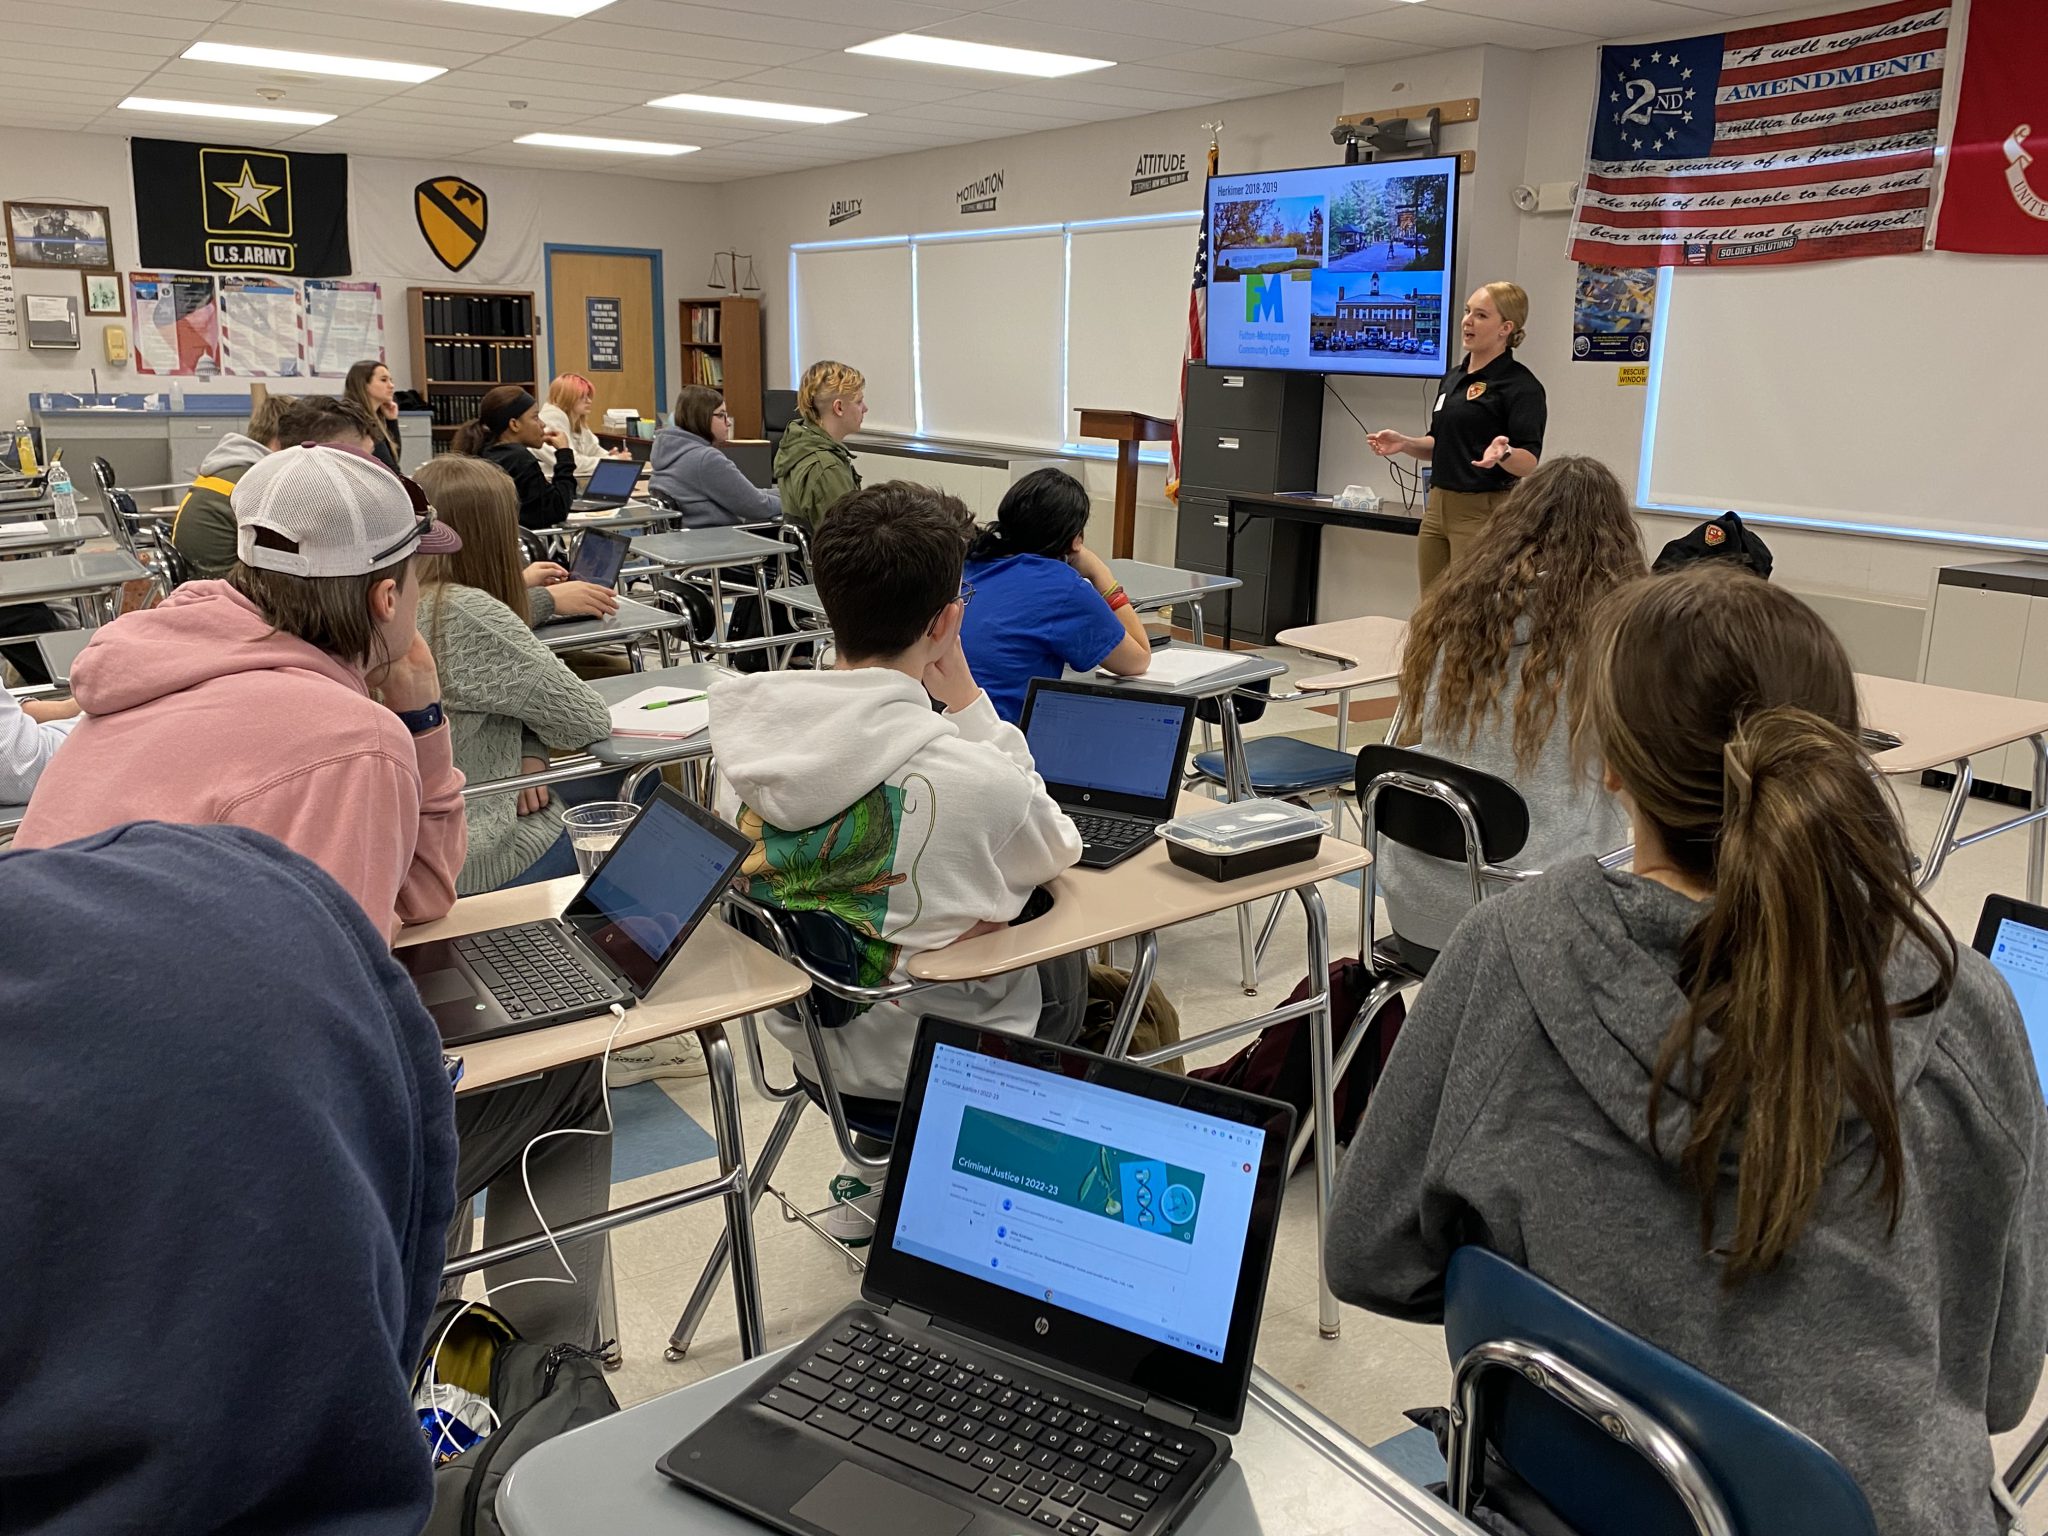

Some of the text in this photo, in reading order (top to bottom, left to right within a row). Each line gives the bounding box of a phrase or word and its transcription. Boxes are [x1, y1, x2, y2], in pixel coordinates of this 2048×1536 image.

[1771, 37, 1819, 60] well
[1826, 11, 1944, 49] regulated
[1724, 51, 1935, 102] AMENDMENT
[1620, 78, 1684, 125] 2ND
[1727, 94, 1933, 135] militia being necessary
[1135, 153, 1186, 176] ATTITUDE
[1603, 134, 1930, 174] to the security of a free state
[956, 169, 1005, 203] MOTIVATION
[1217, 181, 1278, 197] Herkimer 2018-2019
[1597, 172, 1924, 210] the right of the people to keep and
[829, 199, 863, 217] ABILITY
[1589, 226, 1630, 241] bear
[1637, 232, 1678, 241] arms
[1683, 229, 1738, 241] shall
[1743, 229, 1775, 239] not
[1781, 224, 1802, 237] be
[1720, 238, 1794, 257] SOLDIER SOLUTIONS
[958, 1156, 991, 1175] Criminal
[991, 1168, 1020, 1184] Justice
[1025, 1177, 1059, 1196] 2022-23
[1035, 1317, 1049, 1335] hp
